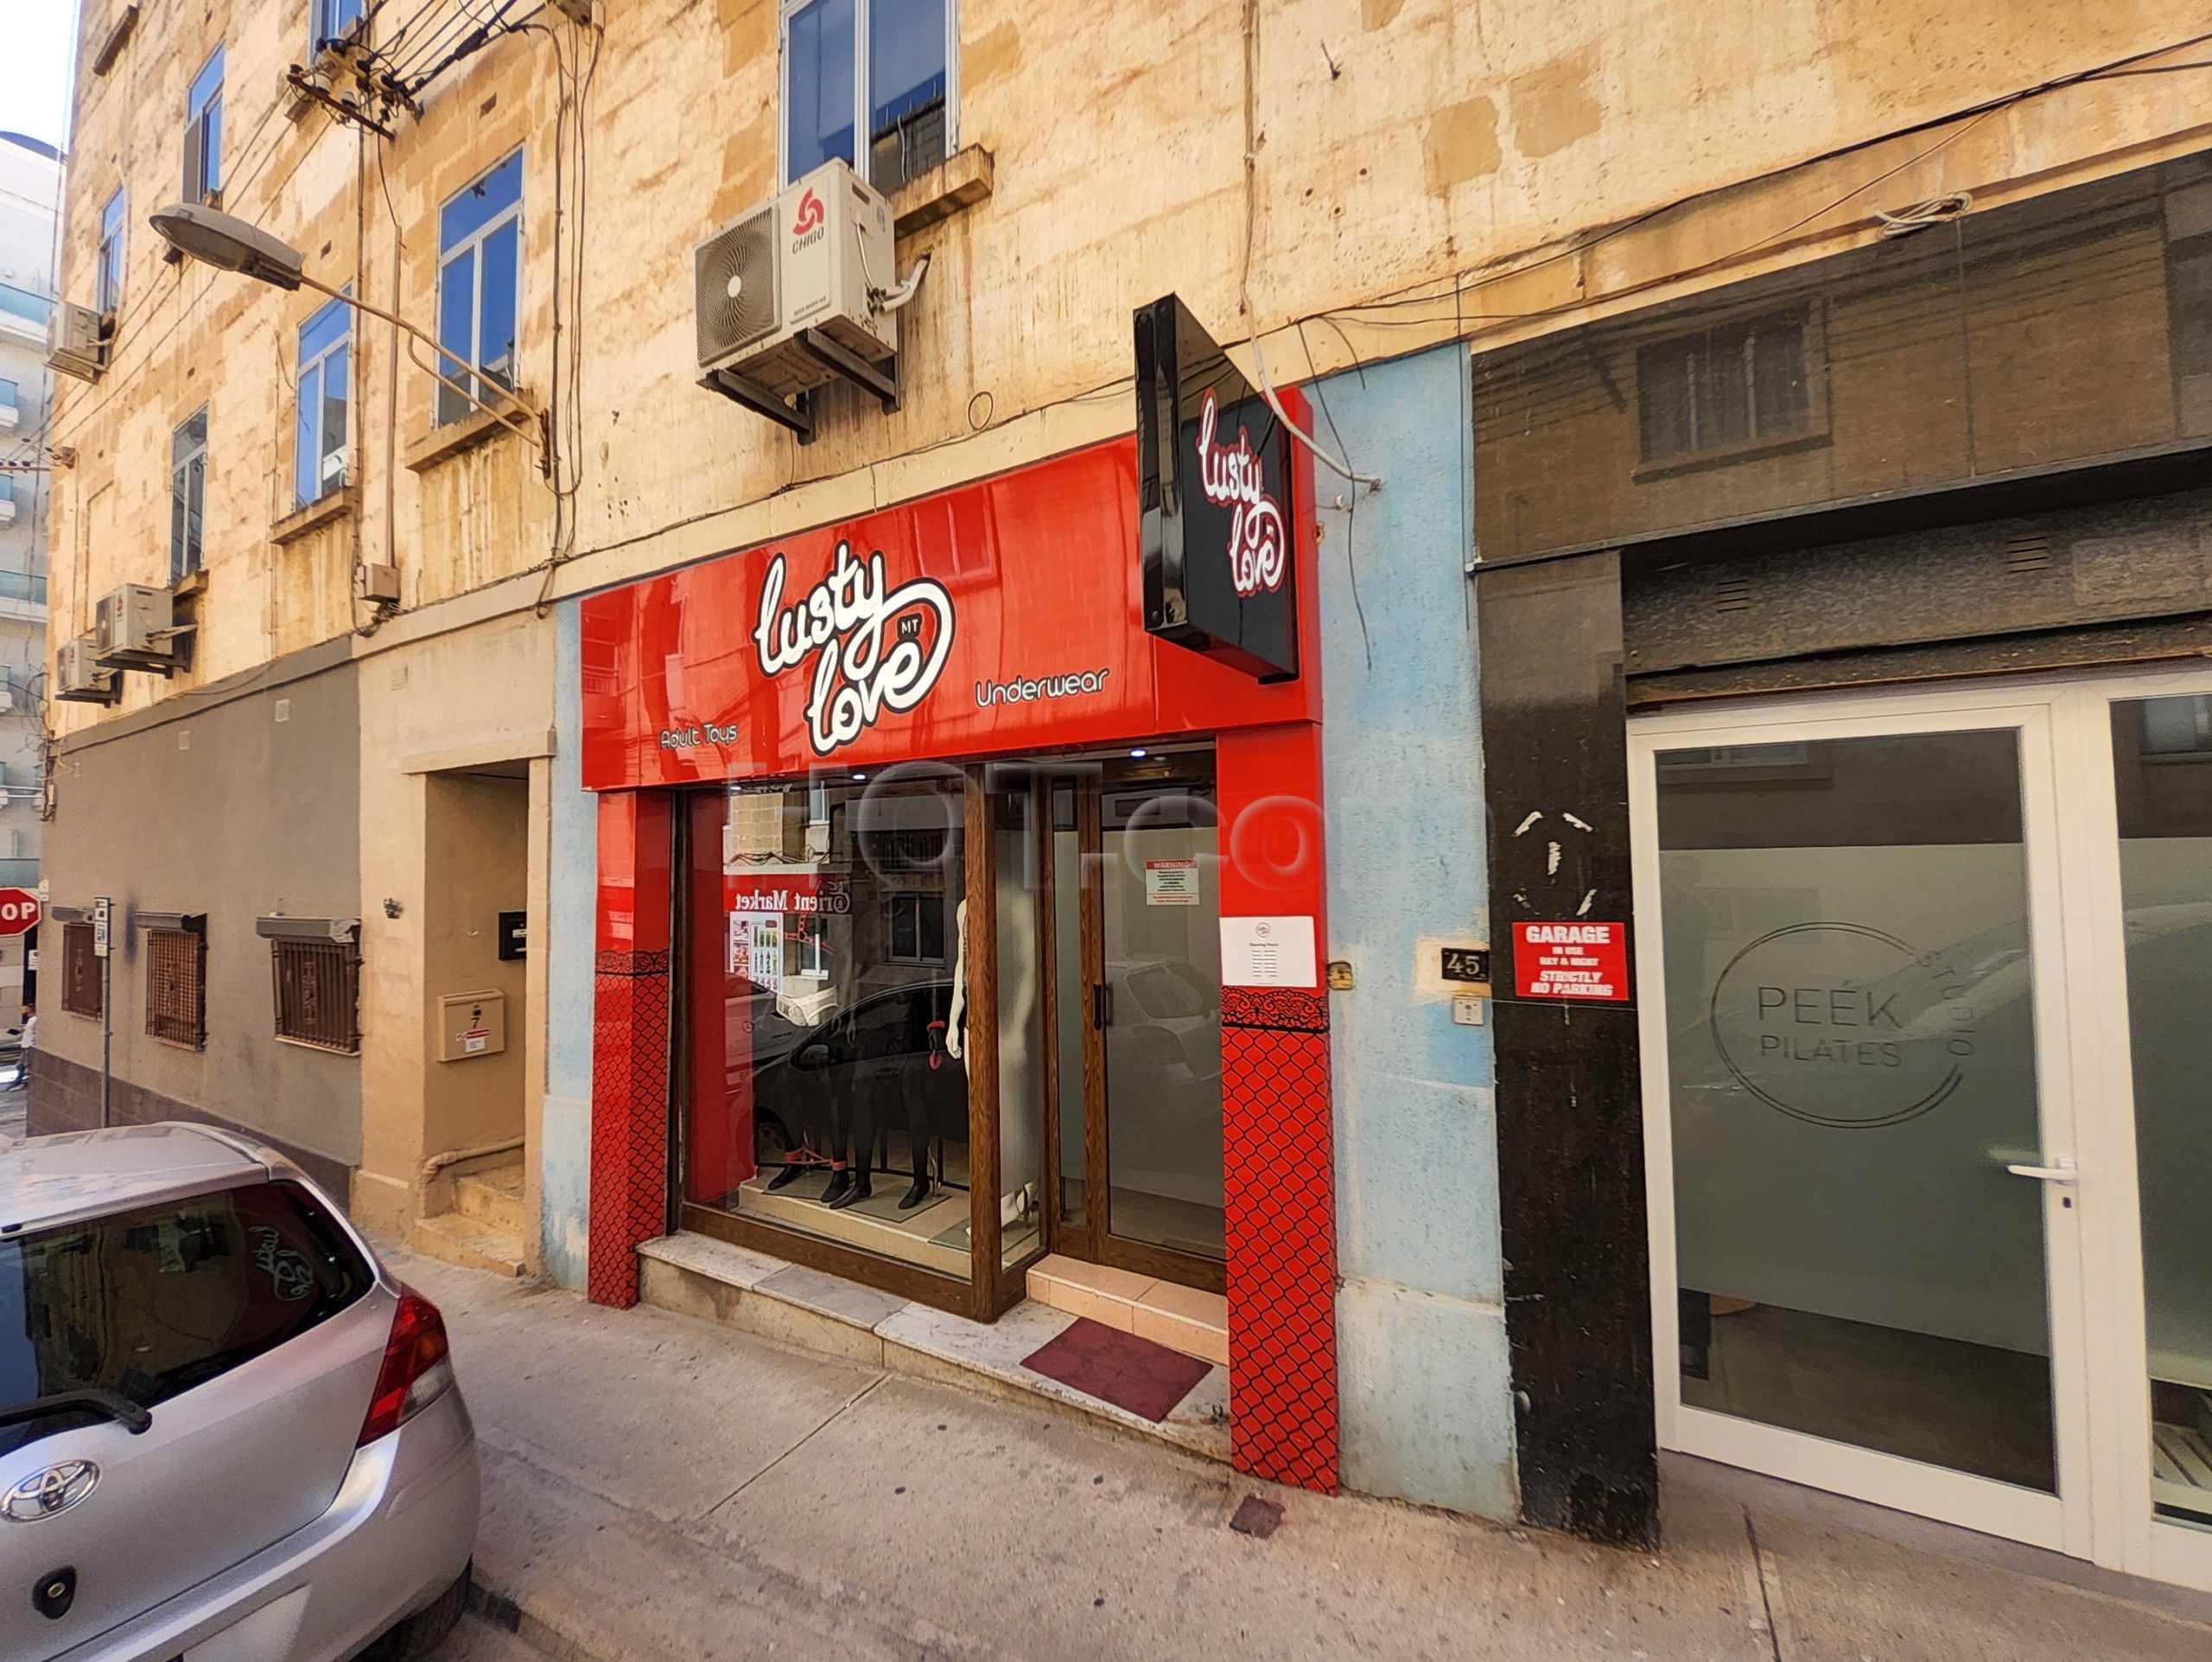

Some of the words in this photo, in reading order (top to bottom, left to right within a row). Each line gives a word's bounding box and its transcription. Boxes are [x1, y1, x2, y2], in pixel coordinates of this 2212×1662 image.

[791, 226, 824, 254] CHIGO
[977, 669, 1109, 707] Underwear
[661, 729, 701, 748] Adult
[703, 723, 737, 745] Toys
[1, 902, 36, 920] OP
[1526, 926, 1611, 944] GARAGE
[1446, 953, 1480, 975] 45
[1539, 971, 1603, 983] STRICTLY
[1553, 983, 1614, 997] PARKING
[1916, 949, 1977, 1056] STUDIO
[470, 1017, 480, 1029] 7
[1761, 1035, 1902, 1067] PILATES
